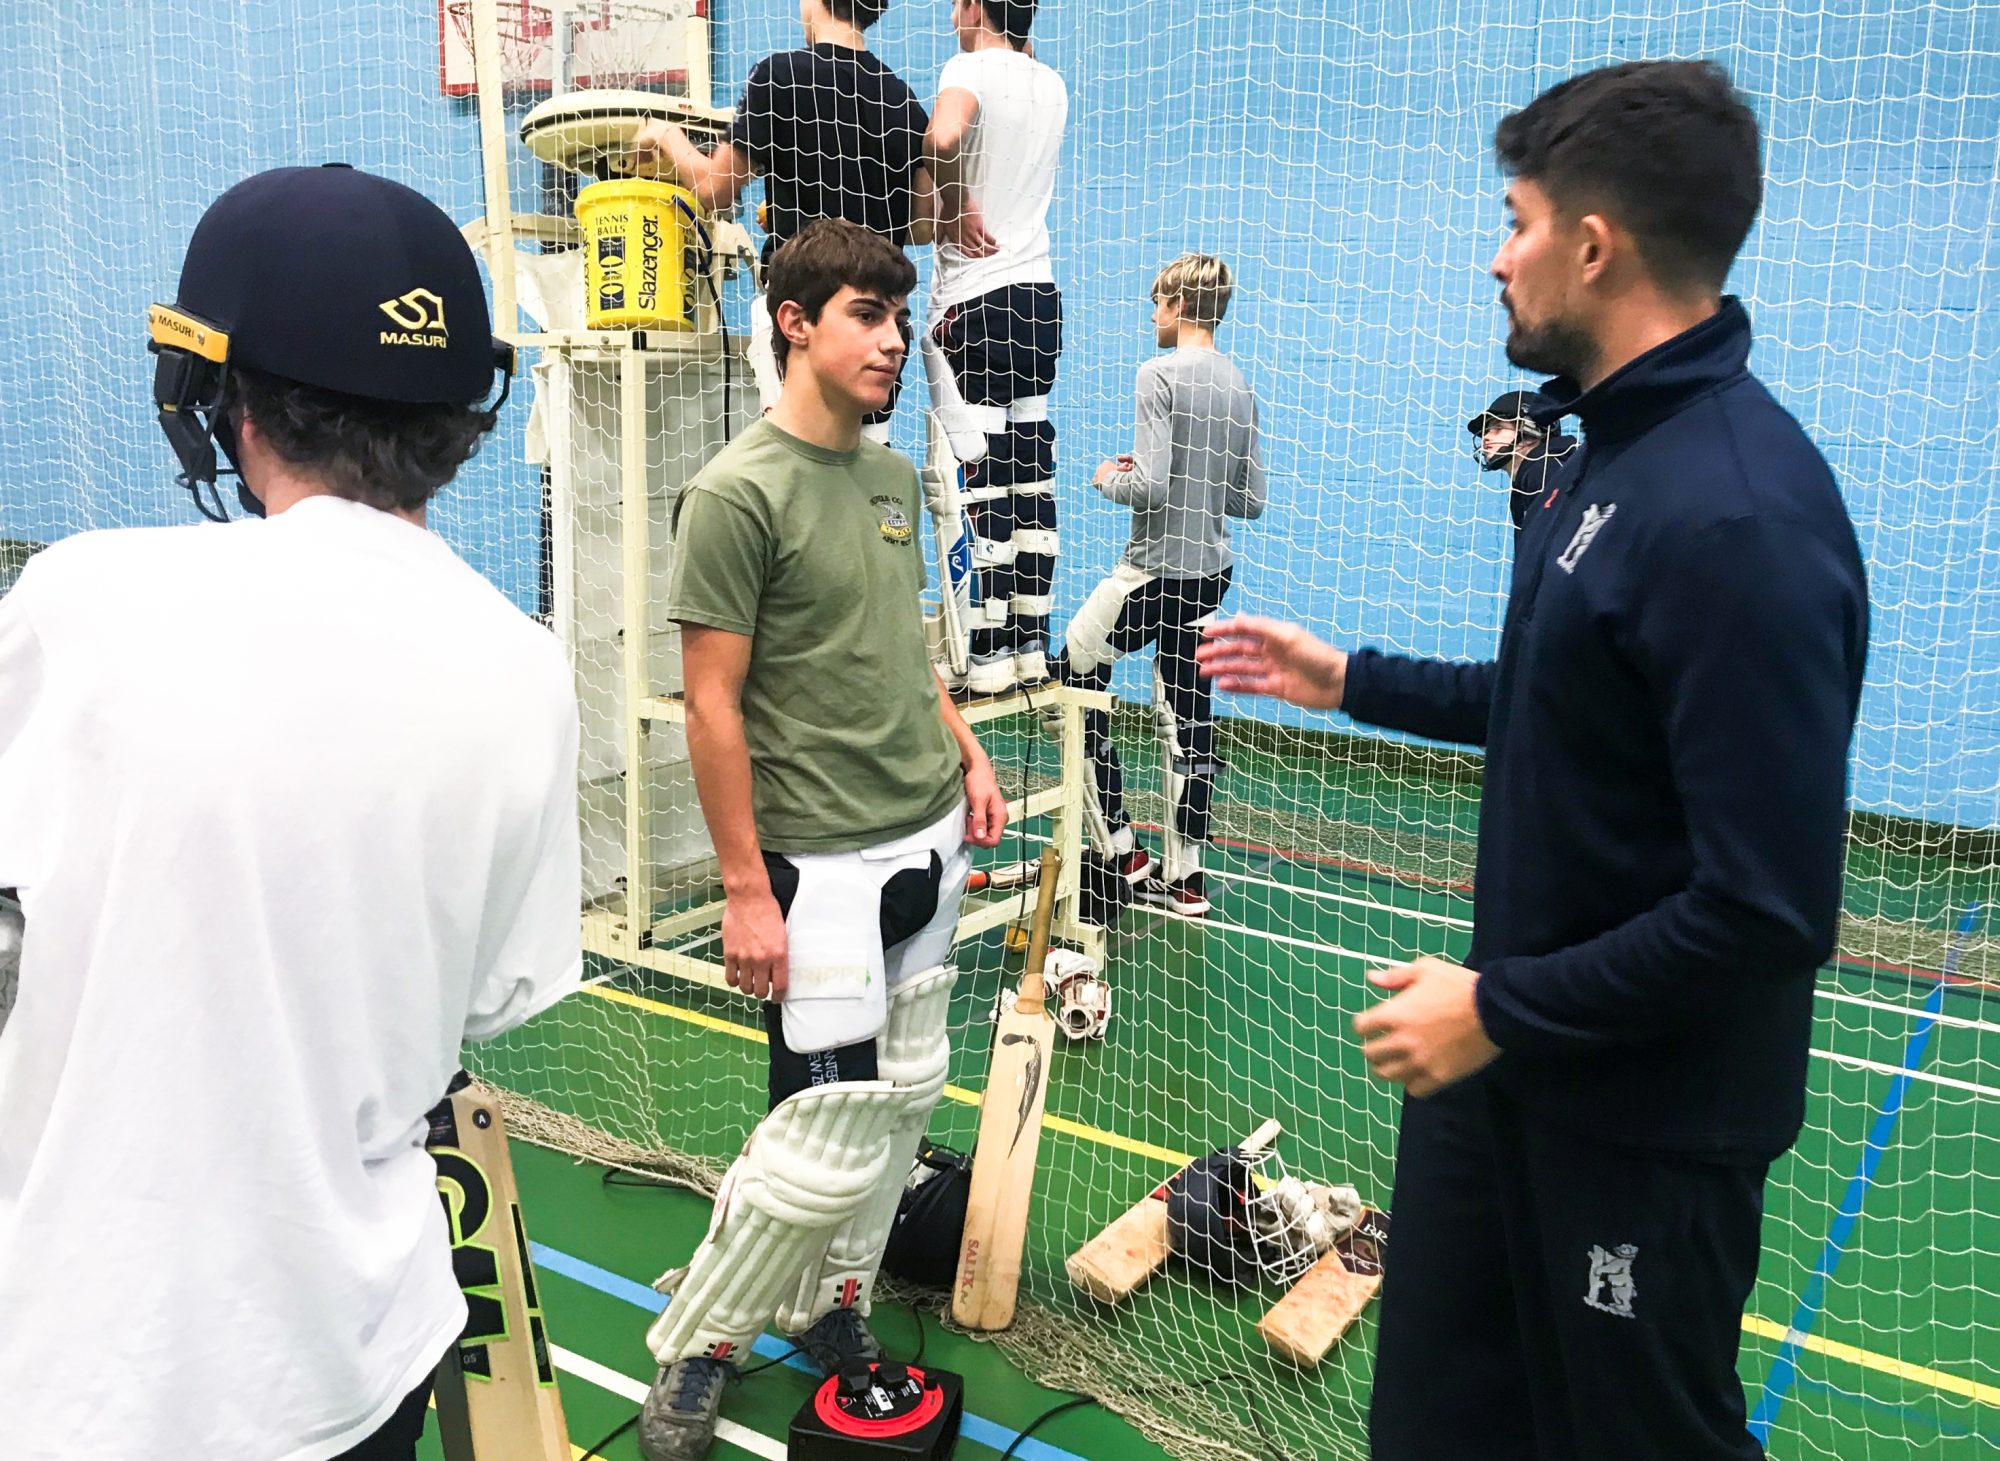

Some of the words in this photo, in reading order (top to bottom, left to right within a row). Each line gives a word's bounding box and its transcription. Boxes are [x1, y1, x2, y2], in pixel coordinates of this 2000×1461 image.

[596, 214, 629, 226] TENNIS
[597, 225, 626, 236] BALLS
[158, 314, 195, 338] MASURI
[379, 331, 448, 349] MASURI
[478, 1113, 487, 1125] A
[962, 1239, 979, 1288] SALIX
